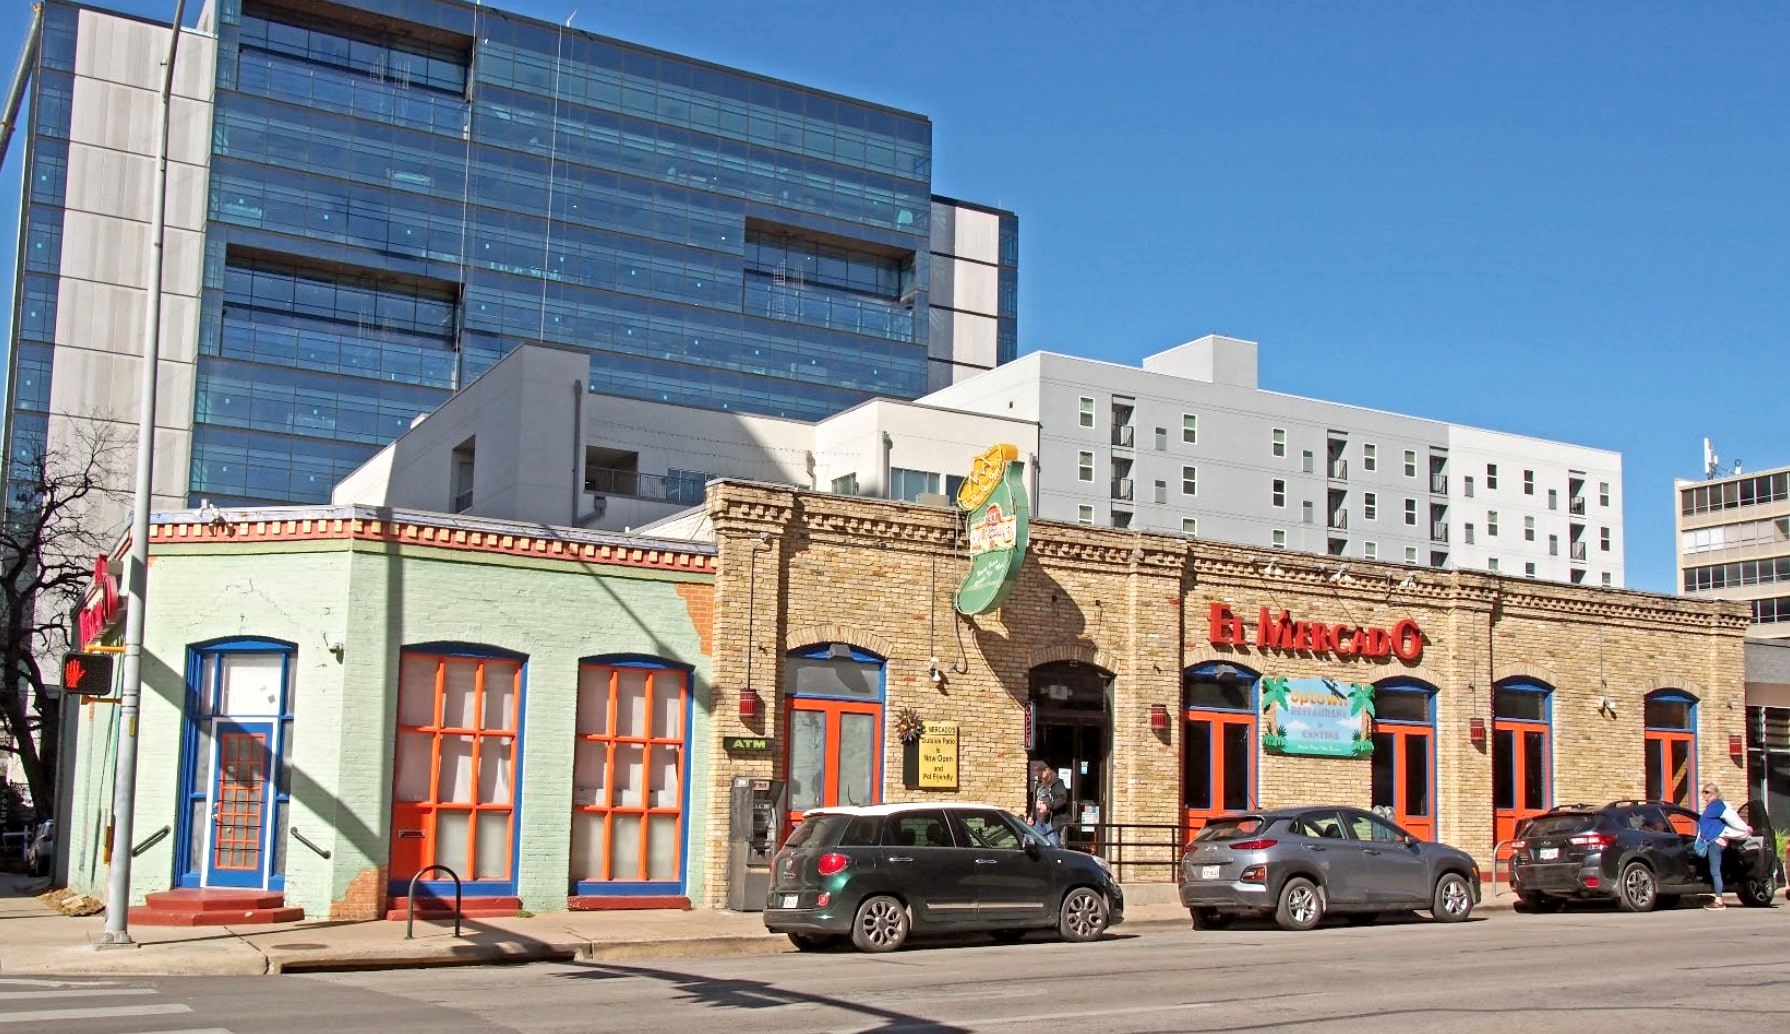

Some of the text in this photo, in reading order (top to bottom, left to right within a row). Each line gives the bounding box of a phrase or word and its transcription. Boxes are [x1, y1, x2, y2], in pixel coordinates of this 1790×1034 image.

[1256, 606, 1423, 659] MERCADO
[1291, 706, 1347, 719] RESTAURANT
[1024, 703, 1032, 748] OPEN
[1302, 729, 1340, 740] CANTINA
[732, 739, 766, 749] ATM
[937, 755, 954, 763] Open
[933, 773, 954, 782] Friendly
